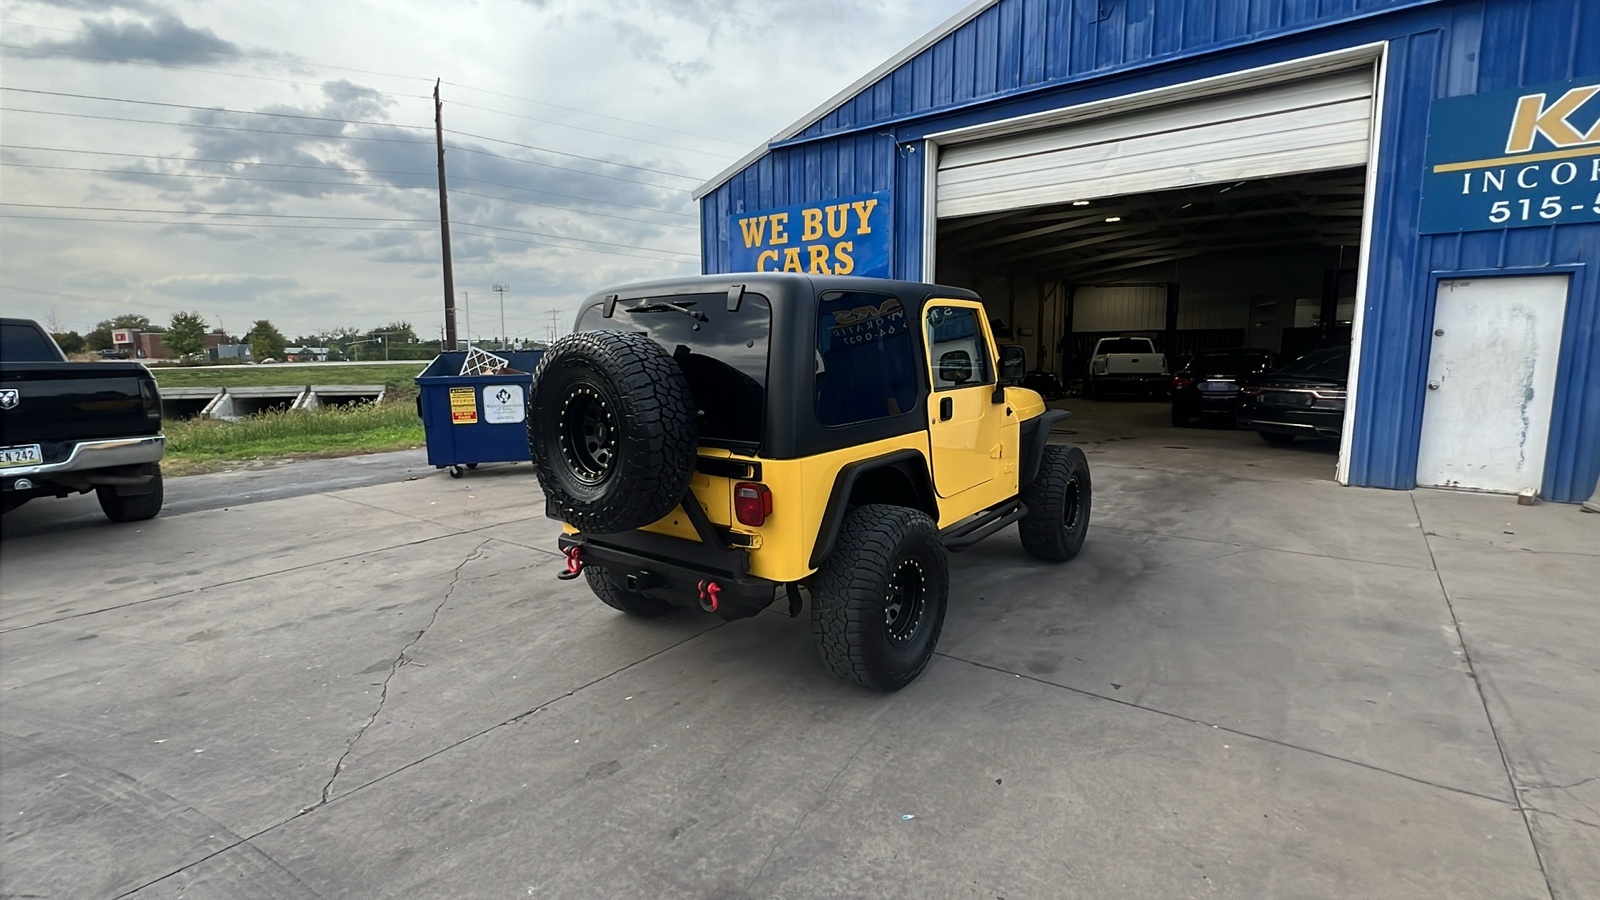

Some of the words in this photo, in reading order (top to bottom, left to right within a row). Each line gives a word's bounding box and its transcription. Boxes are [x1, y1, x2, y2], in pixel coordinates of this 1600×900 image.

[1505, 83, 1600, 154] K
[738, 212, 789, 248] WE
[801, 198, 878, 242] BUY
[756, 240, 855, 275] CARS
[15, 450, 34, 461] 242
